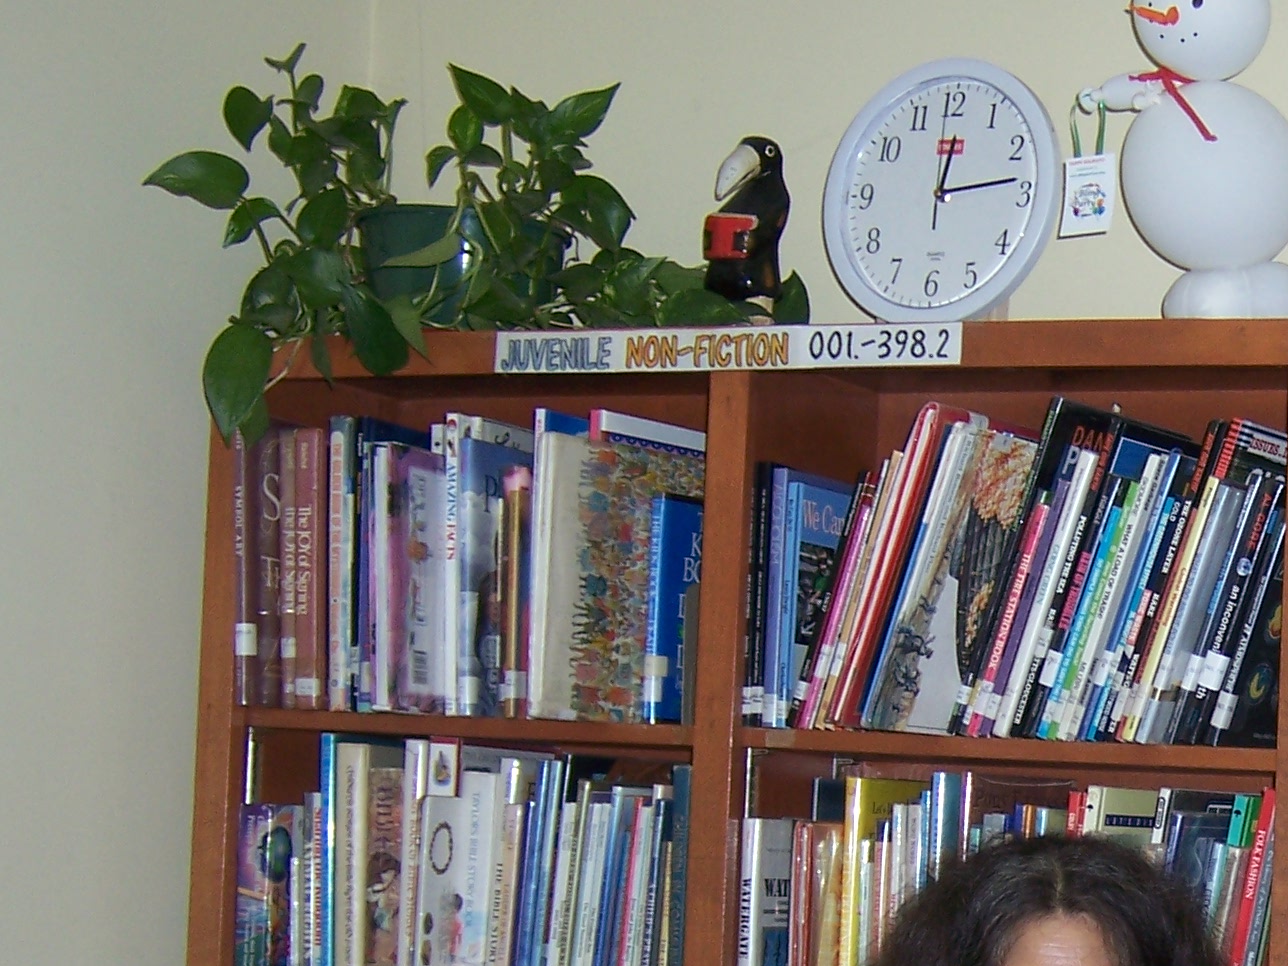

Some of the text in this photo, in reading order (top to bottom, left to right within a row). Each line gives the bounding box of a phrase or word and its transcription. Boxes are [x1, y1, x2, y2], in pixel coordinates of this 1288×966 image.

[910, 104, 928, 131] 11
[942, 92, 966, 117] 12
[986, 103, 997, 129] 1
[878, 136, 901, 162] 10
[1009, 135, 1024, 161] 2
[859, 183, 874, 210] 9
[1015, 181, 1032, 208] 3
[866, 228, 881, 254] 8
[994, 229, 1011, 255] 4
[890, 258, 902, 284] 7
[924, 270, 940, 297] 6
[963, 262, 978, 289] 5
[501, 332, 789, 371] JUVENILE NON-FICTION
[809, 329, 950, 361] 001.-398.2
[446, 464, 456, 560] AMAZING FACTS
[1120, 524, 1134, 546] WHAT
[297, 505, 312, 615] The JOY of Signing
[1056, 515, 1087, 594] POLLUTING THE SEA
[1112, 556, 1124, 578] LOAD
[1109, 579, 1118, 591] OF
[988, 554, 1032, 669] THE FIRE STATION BOOK
[1097, 592, 1114, 619] TRASH!
[1244, 830, 1267, 899] FOLK FASHION
[738, 878, 752, 960] WATERGATE
